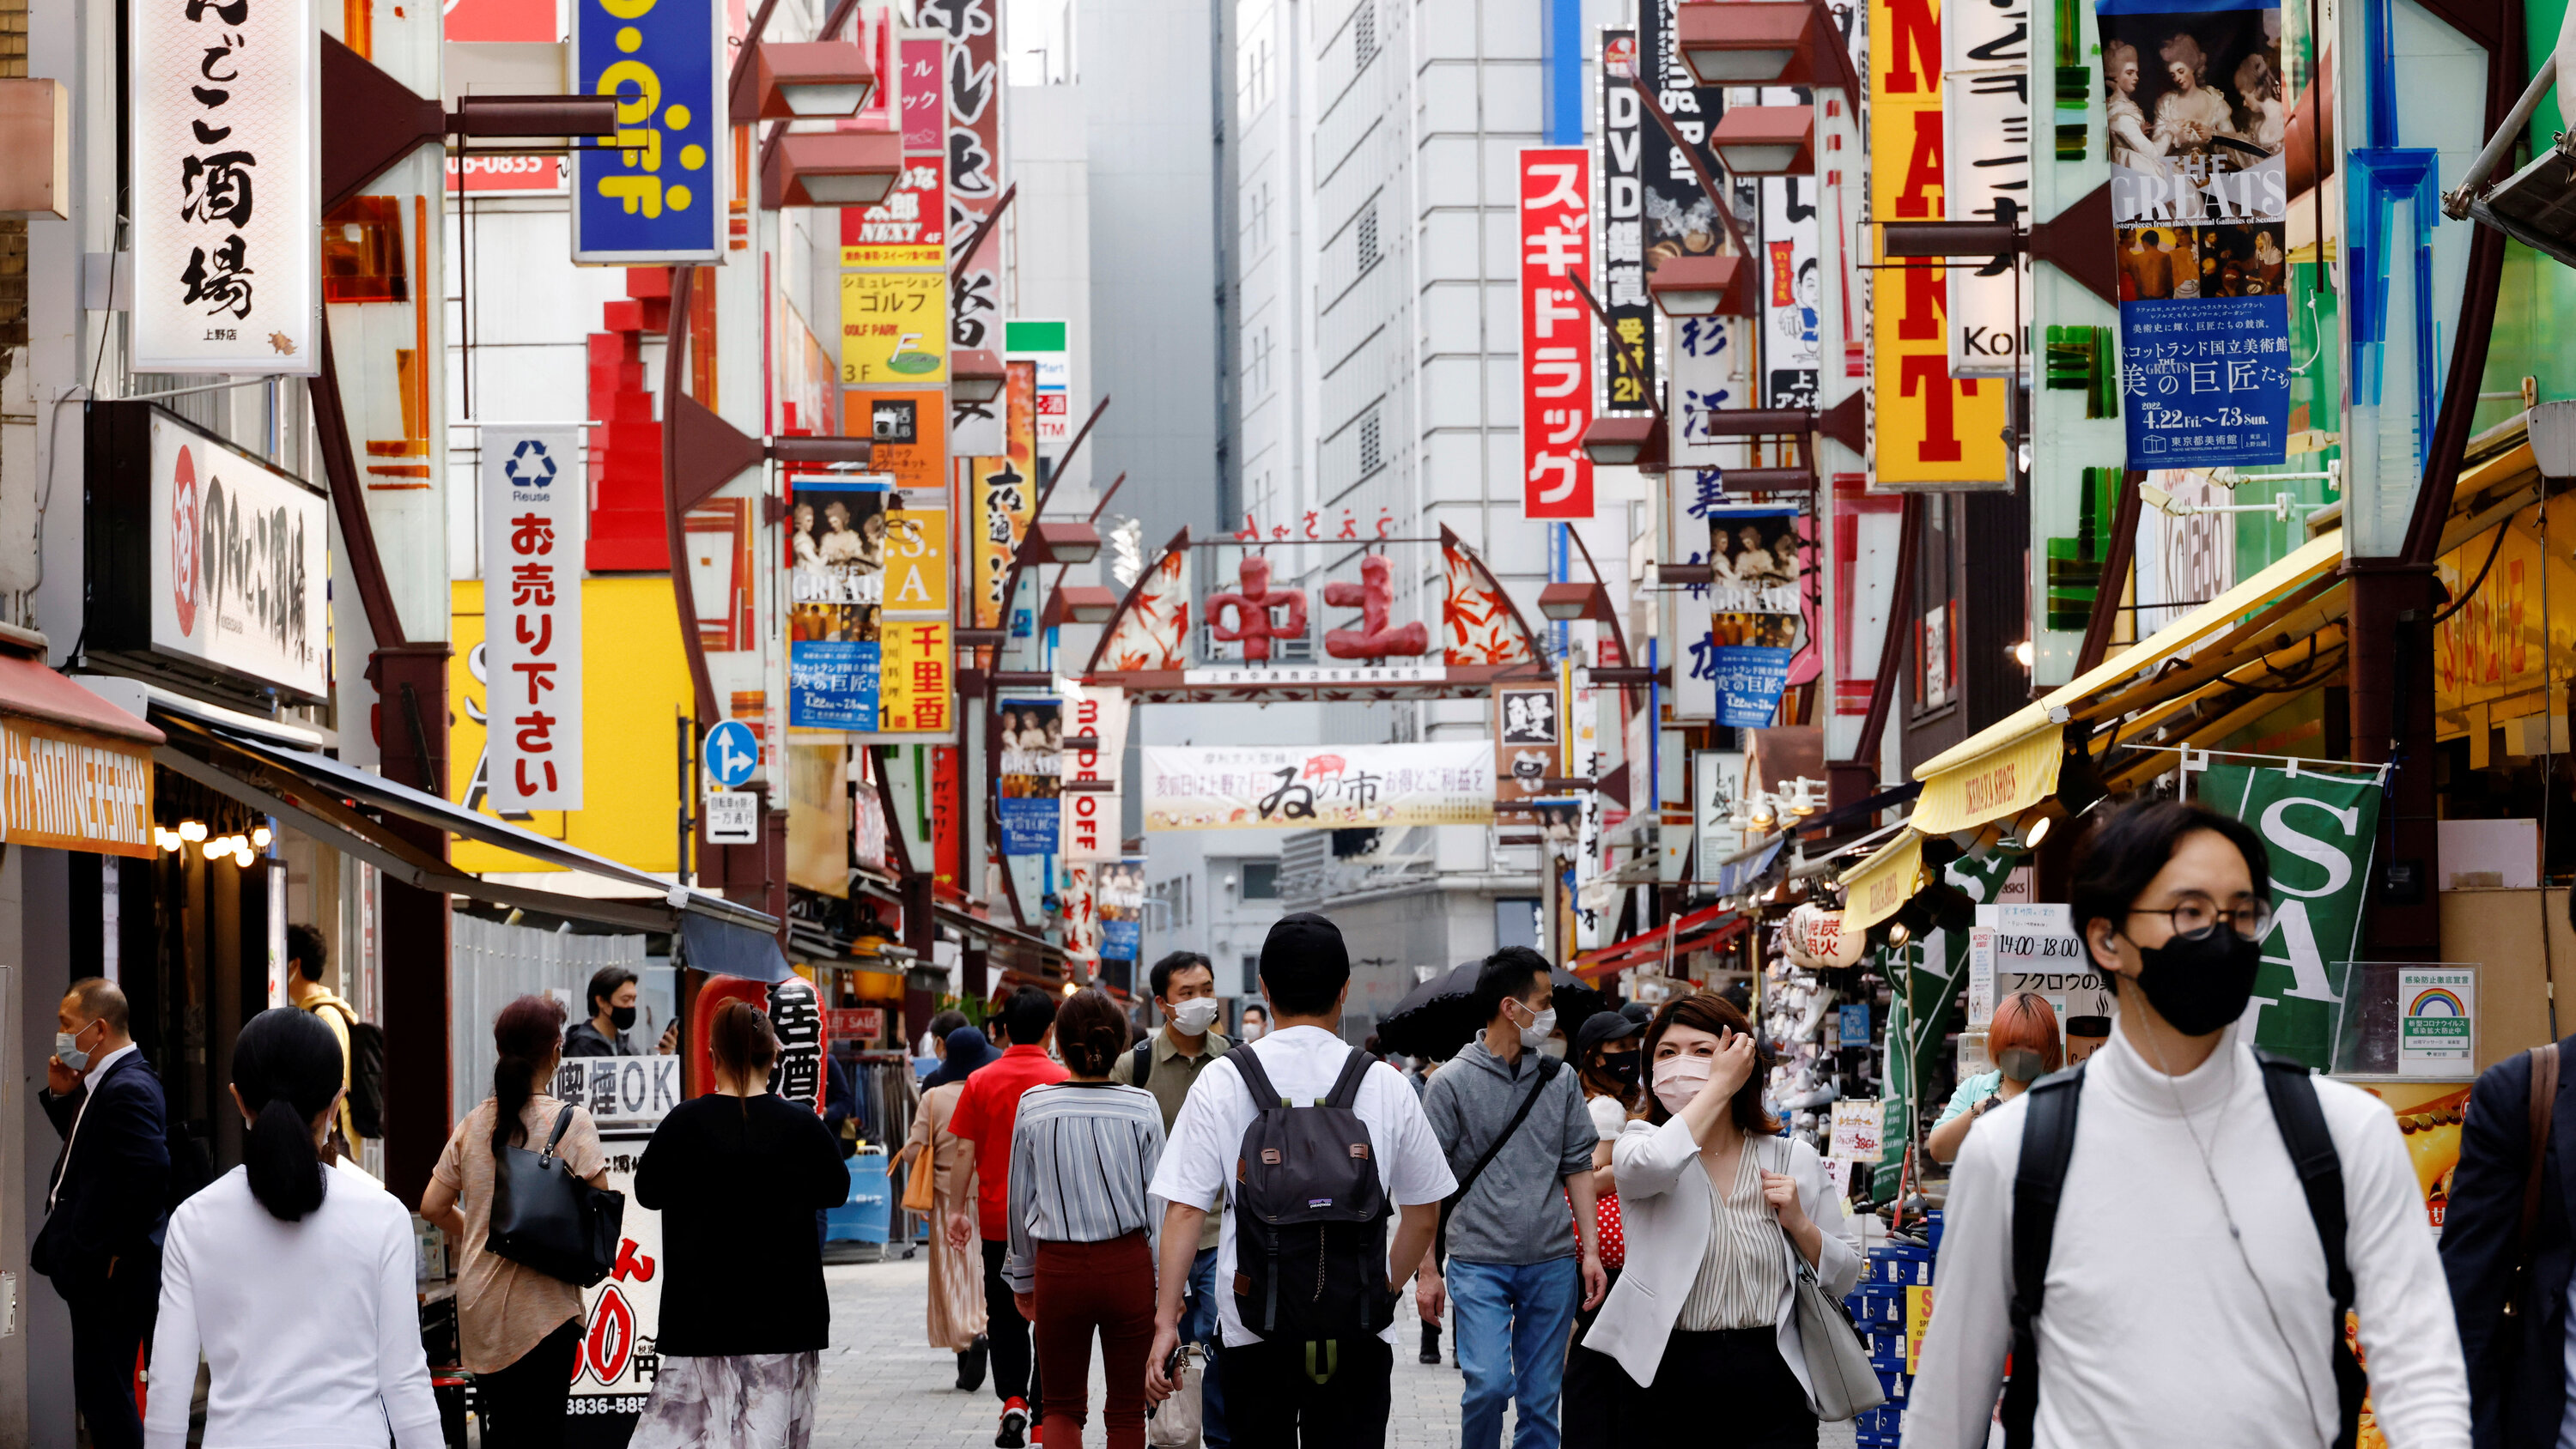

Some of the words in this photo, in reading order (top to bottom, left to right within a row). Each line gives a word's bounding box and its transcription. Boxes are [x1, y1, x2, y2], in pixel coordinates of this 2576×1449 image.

[2160, 154, 2228, 180] THE
[2112, 170, 2287, 222] GREATS
[2184, 218, 2215, 227] National
[2216, 217, 2245, 226] Galleries
[924, 232, 942, 244] 4F
[842, 276, 943, 289] シミュレーション
[860, 291, 926, 312] ゴルフ
[203, 328, 238, 342] 上野店
[1524, 163, 1589, 504] スギドラッグ
[2146, 362, 2190, 375] GREATS
[2122, 358, 2291, 397] 美の巨匠たち
[2141, 402, 2163, 410] 2022.
[2171, 434, 2238, 447] 東京都美術館
[513, 490, 551, 502] Reuse
[511, 512, 556, 797] お売り下さい
[911, 625, 945, 730] 千里香
[1994, 762, 2016, 807] SHOES
[711, 811, 754, 825] 一方通行
[1076, 796, 1097, 851] OFF
[1820, 919, 1841, 957] 炭火
[2404, 975, 2470, 984] 感染防止徹底宣言
[848, 1015, 877, 1029] SALE
